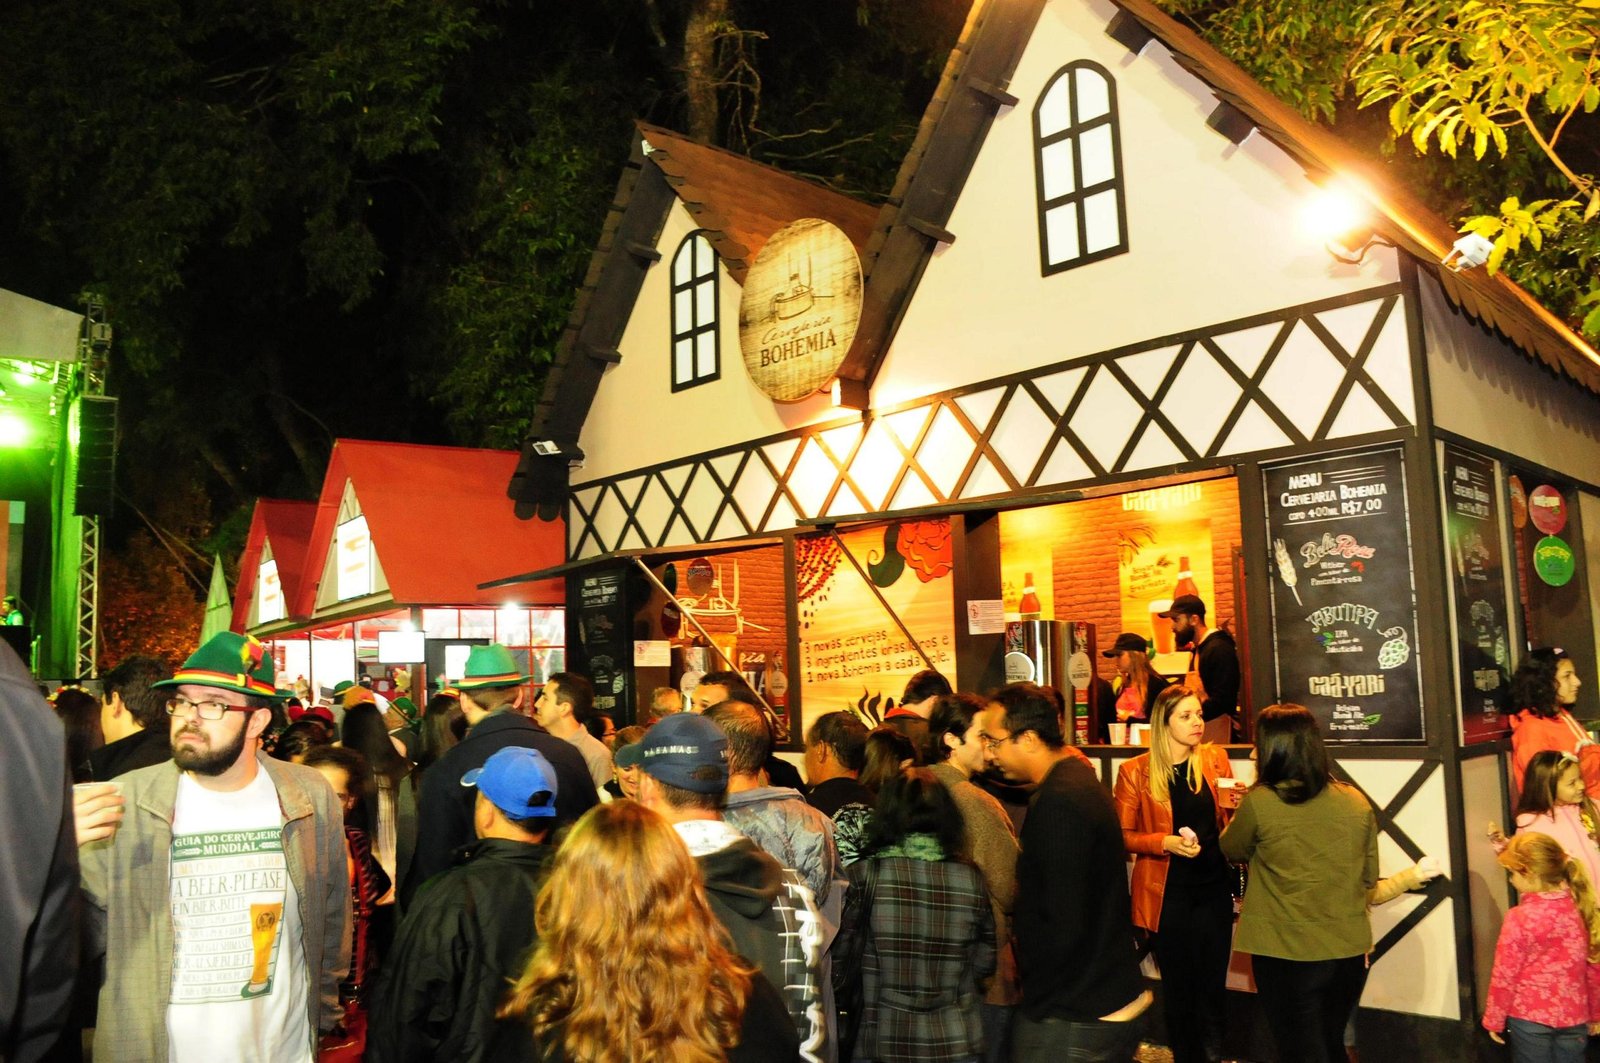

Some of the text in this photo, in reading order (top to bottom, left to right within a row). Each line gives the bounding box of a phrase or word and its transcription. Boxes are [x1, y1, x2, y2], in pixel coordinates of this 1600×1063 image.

[760, 328, 837, 368] BOHEMIA
[1288, 472, 1323, 490] MENU
[1339, 483, 1388, 500] BOHEMIA
[804, 642, 810, 654] 3
[814, 638, 841, 651] novas
[806, 656, 812, 669] 3
[942, 635, 949, 646] e
[807, 671, 814, 683] 1
[817, 669, 839, 682] nova
[885, 661, 892, 671] a
[895, 654, 920, 669] cada
[644, 745, 692, 758] BAHAMAS
[174, 836, 202, 848] GUIA
[204, 834, 218, 844] DO
[203, 841, 259, 856] MUNDIAL
[173, 879, 183, 898] A
[234, 871, 282, 892] PLEASE
